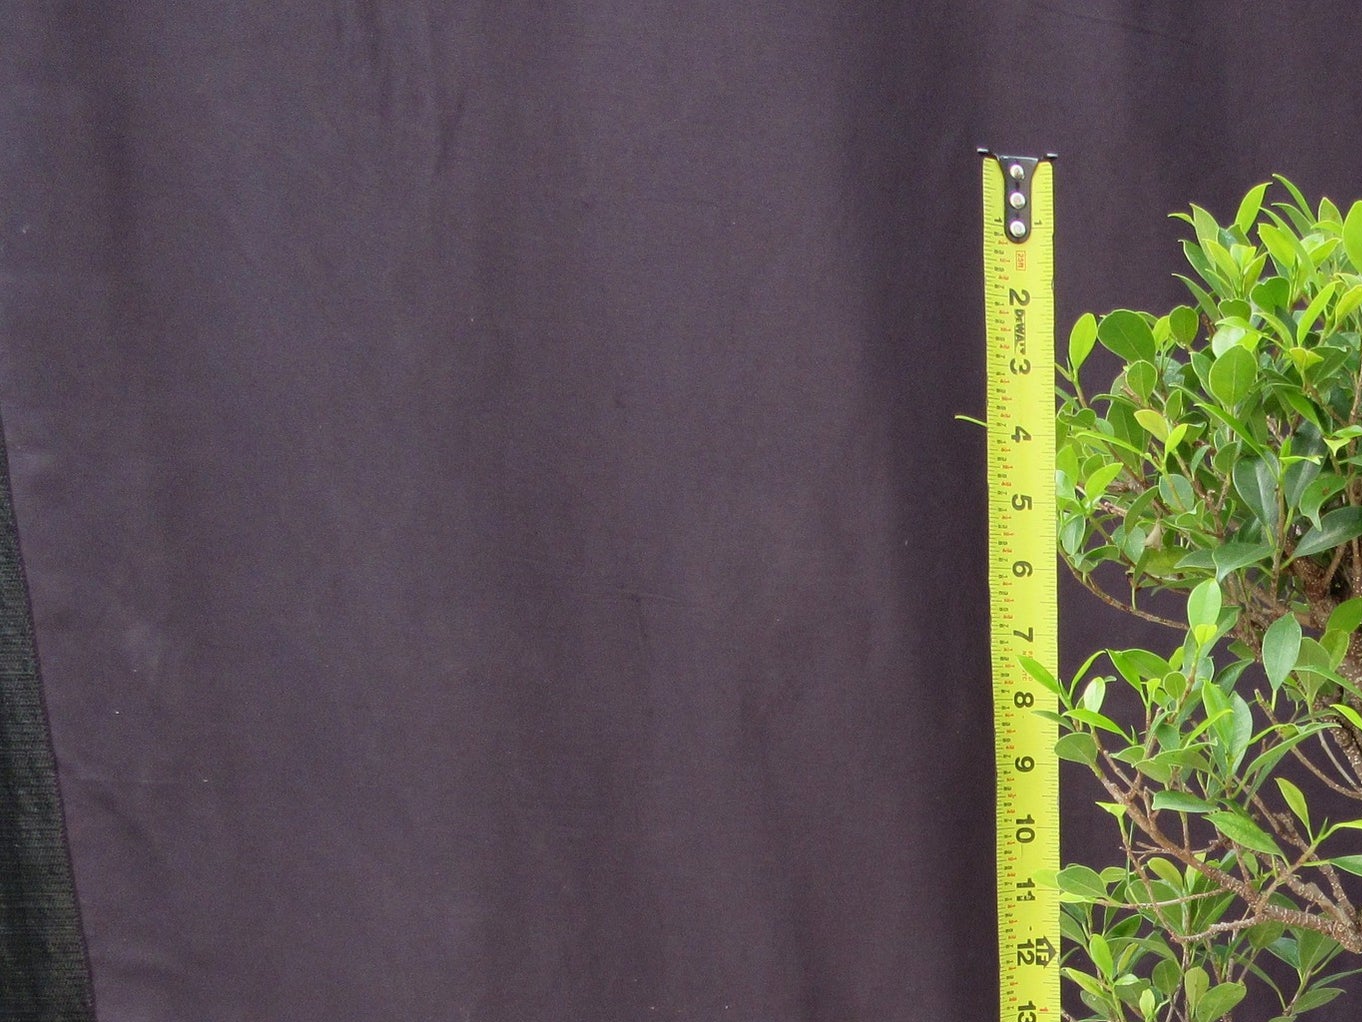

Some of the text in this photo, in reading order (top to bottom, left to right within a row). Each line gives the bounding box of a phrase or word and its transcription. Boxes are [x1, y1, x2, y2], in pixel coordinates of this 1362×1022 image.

[1009, 289, 1030, 306] 2
[1010, 358, 1030, 375] 3
[1011, 426, 1031, 443] 4
[1012, 494, 1032, 511] 5
[1013, 561, 1033, 577] 6
[1013, 628, 1033, 643] 7
[1014, 691, 1034, 708] 8
[1015, 756, 1035, 773] 9
[1016, 814, 1035, 843] 10
[1016, 878, 1035, 901] 11
[1017, 939, 1034, 966] 12
[1036, 943, 1049, 962] 1F
